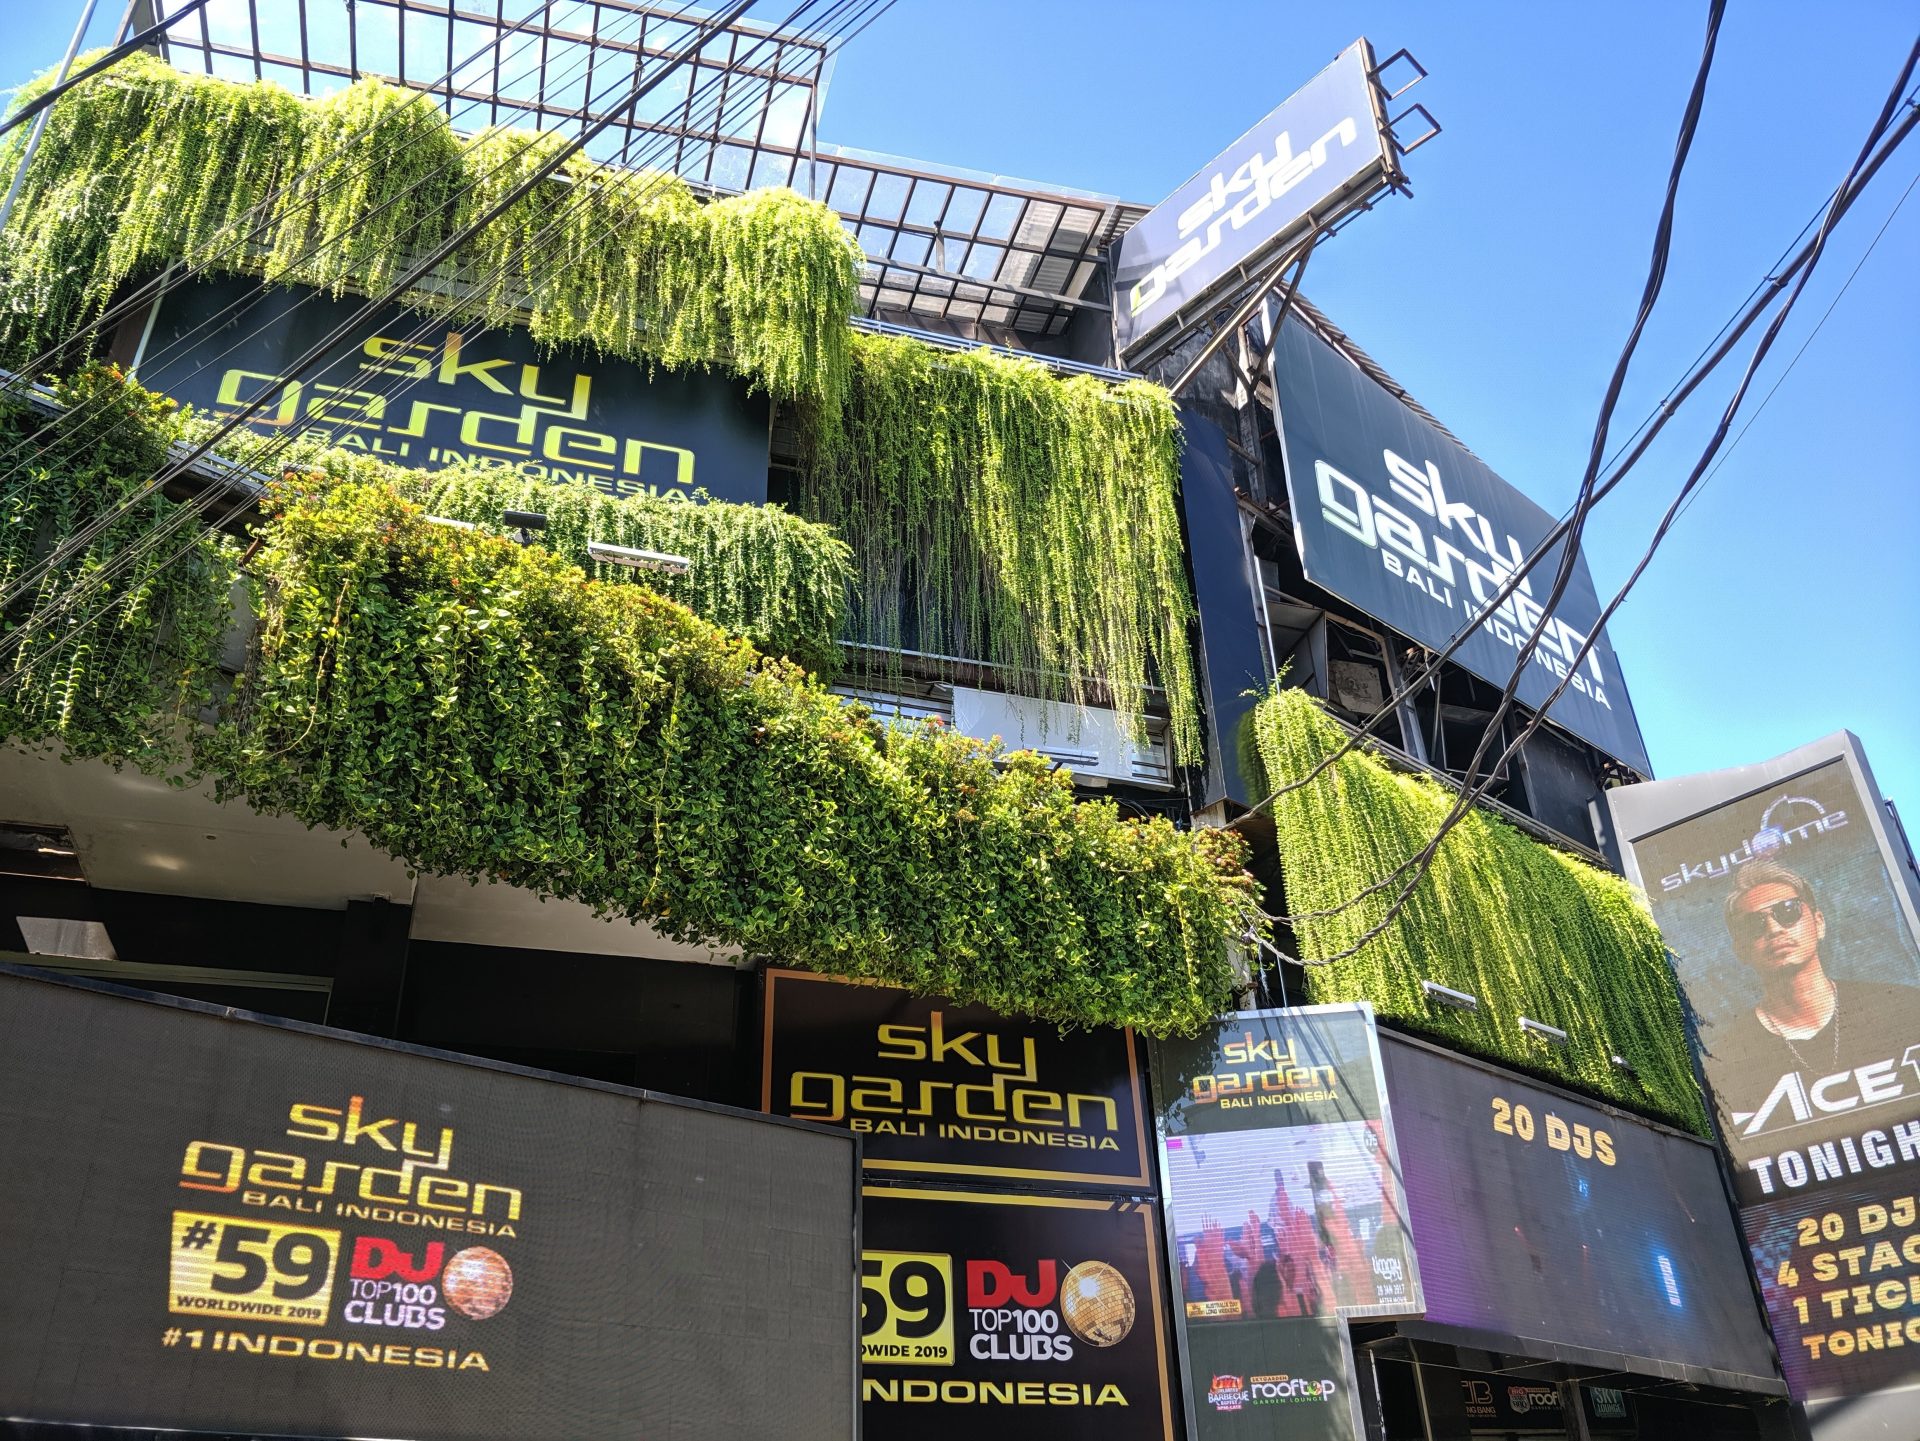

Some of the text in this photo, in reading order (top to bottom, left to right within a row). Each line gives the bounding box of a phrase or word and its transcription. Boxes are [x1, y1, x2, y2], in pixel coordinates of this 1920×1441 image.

[1177, 130, 1293, 239] sky
[1130, 116, 1358, 317] garden
[360, 331, 591, 421] sky
[213, 369, 696, 485] garden
[1383, 448, 1532, 597] sky
[1314, 459, 1605, 686] garden
[1381, 547, 1453, 609] BALI
[877, 1010, 1037, 1083] sky
[1223, 1031, 1297, 1067] sky
[789, 1070, 1120, 1131] garden
[1191, 1062, 1337, 1105] garden
[1220, 1089, 1340, 1110] BALI INDONESIA
[286, 1094, 454, 1171] sky
[850, 1117, 1121, 1152] BALI INDONESIA
[1491, 1096, 1617, 1167] 20 DJS
[179, 1139, 522, 1221] garden
[242, 1190, 518, 1238] BALI INDONESIA
[1797, 1212, 1845, 1247] 20
[350, 1235, 446, 1283] DJ
[1777, 1260, 1799, 1288] 4
[177, 1295, 323, 1320] WORLDWIDE 2019
[966, 1259, 1057, 1309] DJ
[344, 1300, 447, 1330] CLUBS
[1793, 1295, 1810, 1325] 1
[212, 1330, 491, 1372] INDONESIA
[914, 1345, 948, 1359] 2019
[969, 1333, 1074, 1362] CLUBS
[1207, 1390, 1250, 1404] BARBECUE
